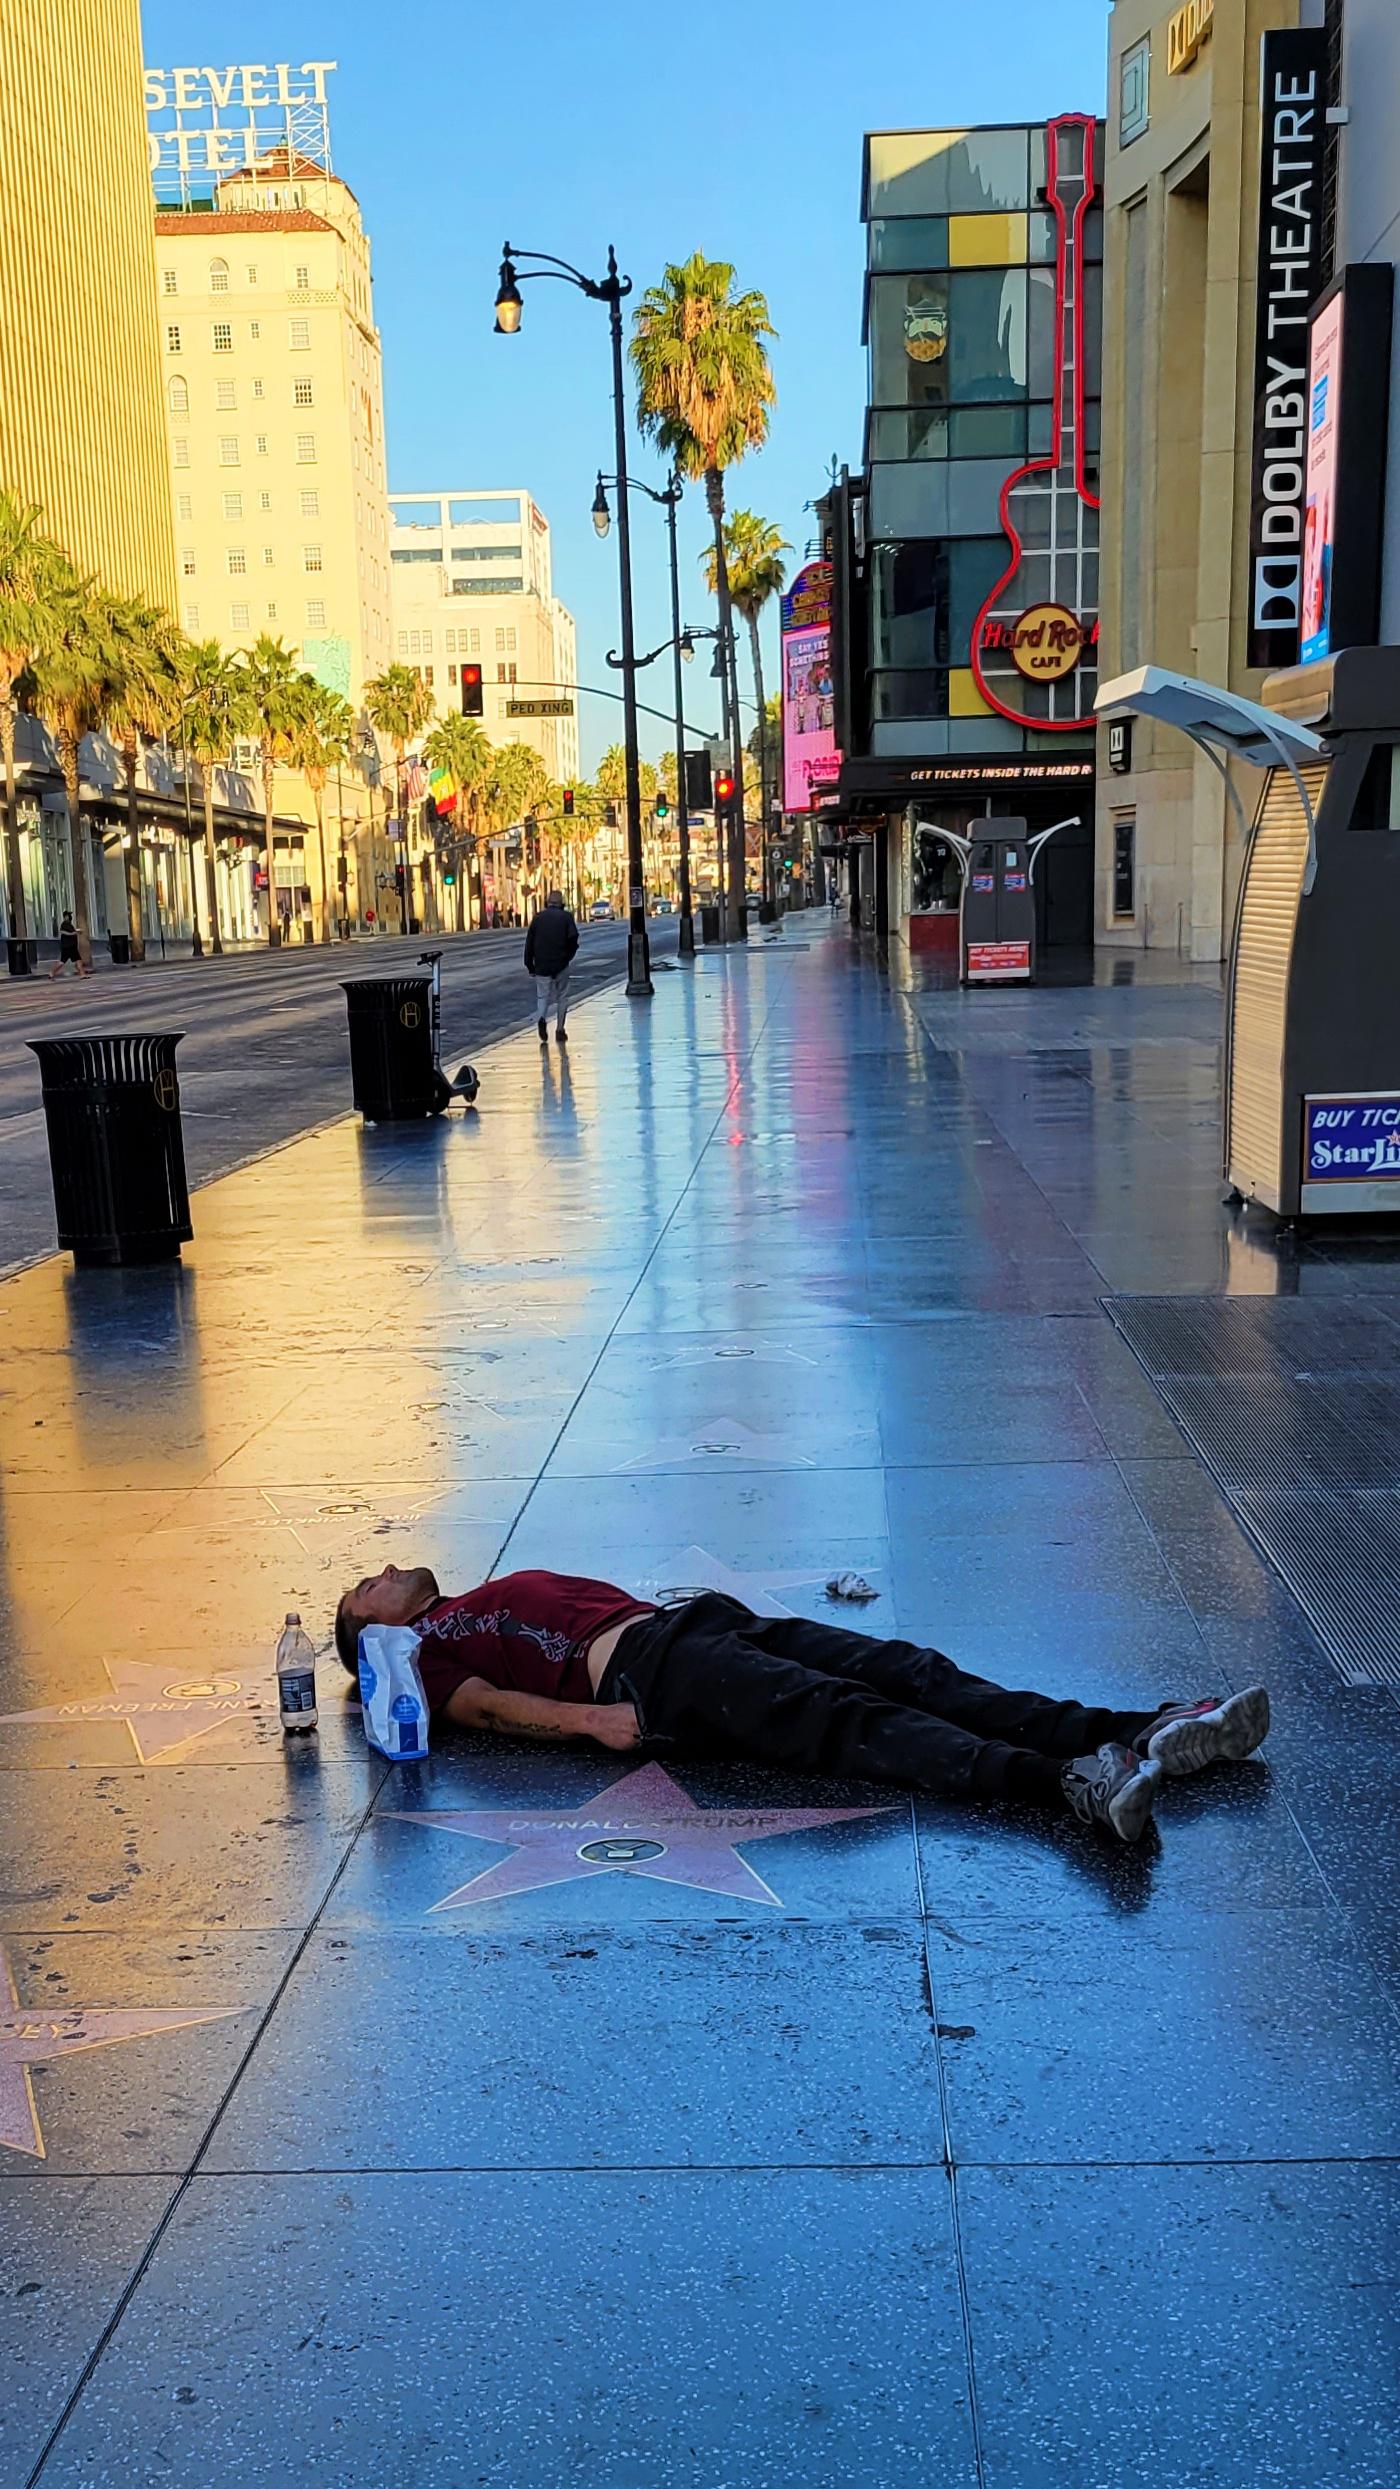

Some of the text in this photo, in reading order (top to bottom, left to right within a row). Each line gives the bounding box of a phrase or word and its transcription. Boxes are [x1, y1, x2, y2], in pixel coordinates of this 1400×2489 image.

[1261, 70, 1316, 543] DOLBY THEATRE
[982, 620, 1047, 649] Hard
[511, 703, 569, 714] PED XING
[911, 770, 932, 781] GET
[933, 768, 981, 780] TICKETS
[981, 767, 1021, 779] INSIDE
[1022, 766, 1045, 777] THE
[1045, 765, 1082, 776] HARD
[1312, 1110, 1356, 1128] BUY
[58, 1700, 193, 1716] FREEMAN
[508, 1816, 778, 1831] DONALD TRUMP
